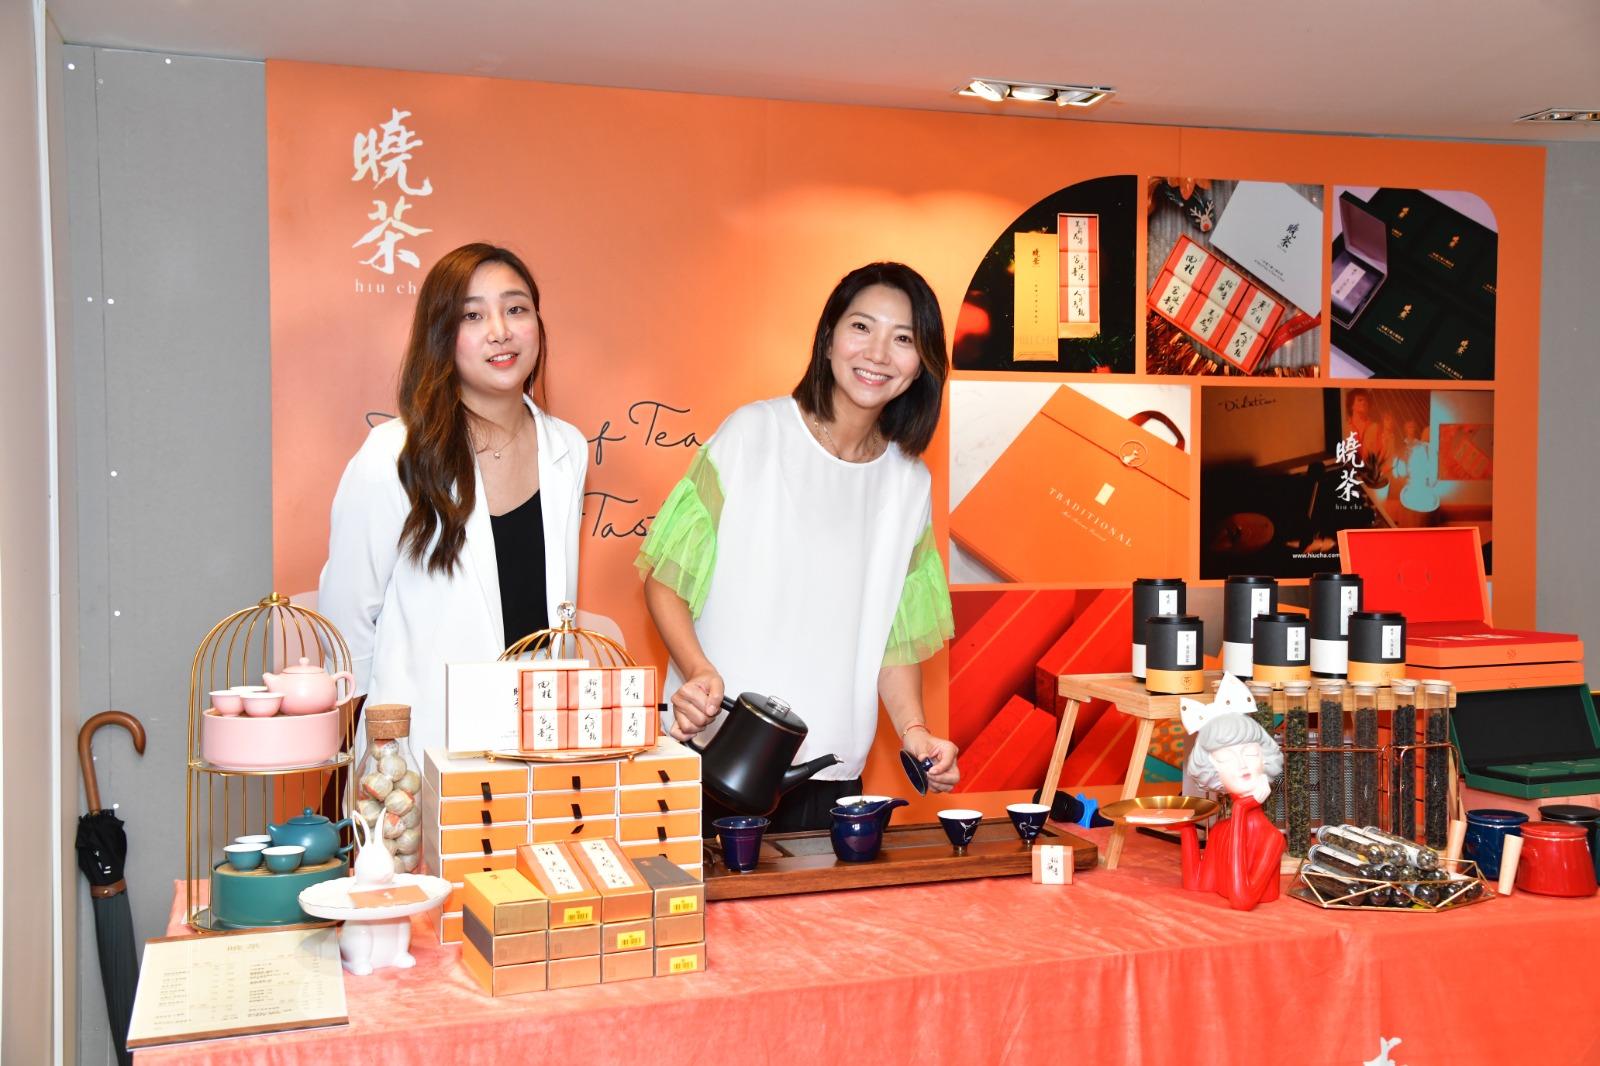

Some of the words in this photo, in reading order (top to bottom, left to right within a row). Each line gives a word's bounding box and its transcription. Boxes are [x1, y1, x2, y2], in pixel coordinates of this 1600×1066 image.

[396, 281, 417, 295] ch
[628, 400, 703, 448] Tea
[1049, 487, 1132, 547] TRADITIONAL
